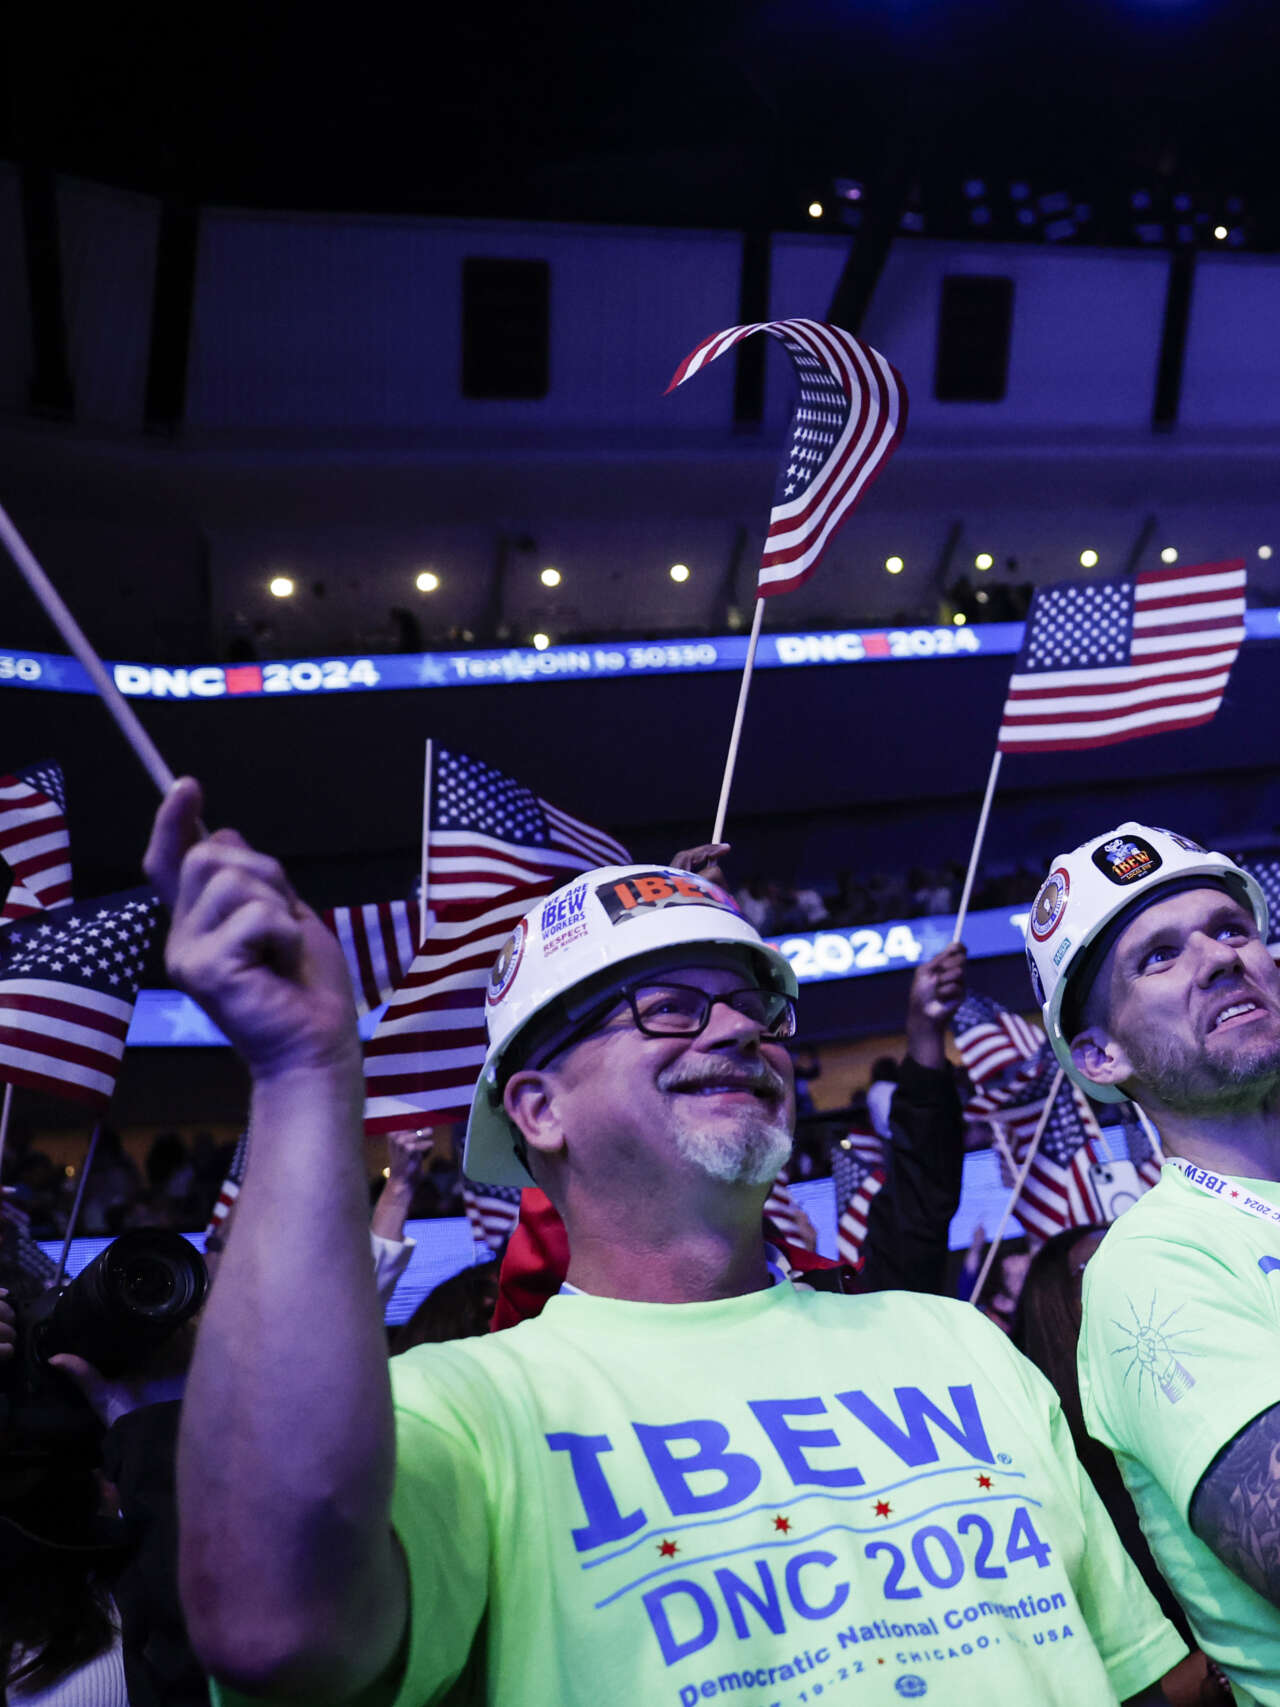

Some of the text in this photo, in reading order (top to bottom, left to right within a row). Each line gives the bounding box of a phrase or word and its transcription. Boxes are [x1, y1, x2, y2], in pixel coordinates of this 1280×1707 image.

[776, 628, 980, 664] DNC 2024
[114, 659, 381, 698] DNC 2024
[542, 890, 587, 931] IBEW
[543, 911, 586, 940] WORKERS
[780, 925, 923, 977] 2024
[1184, 1164, 1228, 1194] IBEW
[1243, 1197, 1271, 1215] 2024
[545, 1384, 997, 1552] IBEW
[641, 1506, 1052, 1667] DNC 2024
[1033, 1625, 1075, 1646] USA
[679, 1647, 831, 1707] Democratic
[836, 1618, 939, 1650] National
